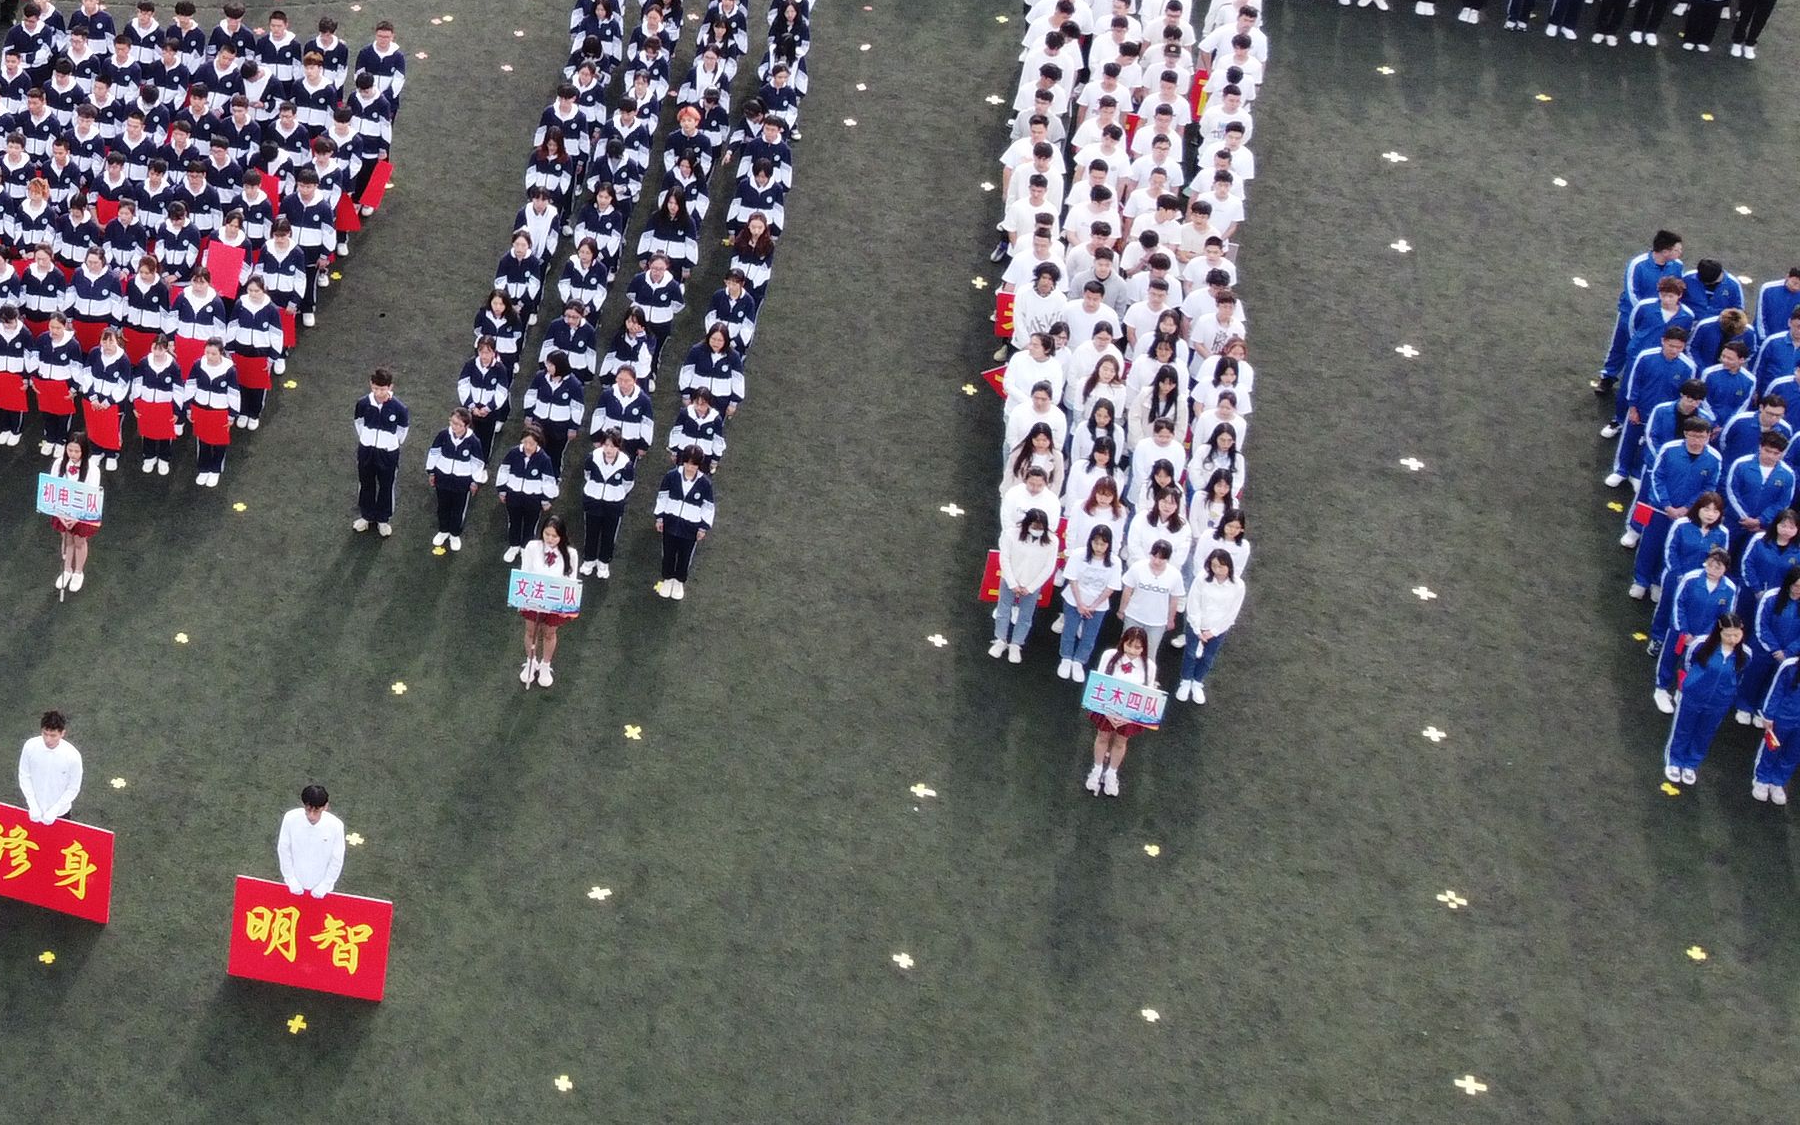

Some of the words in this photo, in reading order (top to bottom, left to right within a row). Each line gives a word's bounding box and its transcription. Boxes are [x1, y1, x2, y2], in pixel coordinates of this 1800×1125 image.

[43, 482, 99, 513] 机电三队
[515, 578, 576, 606] 文法二队
[1090, 681, 1159, 717] 土木四队
[245, 904, 374, 975] 明智
